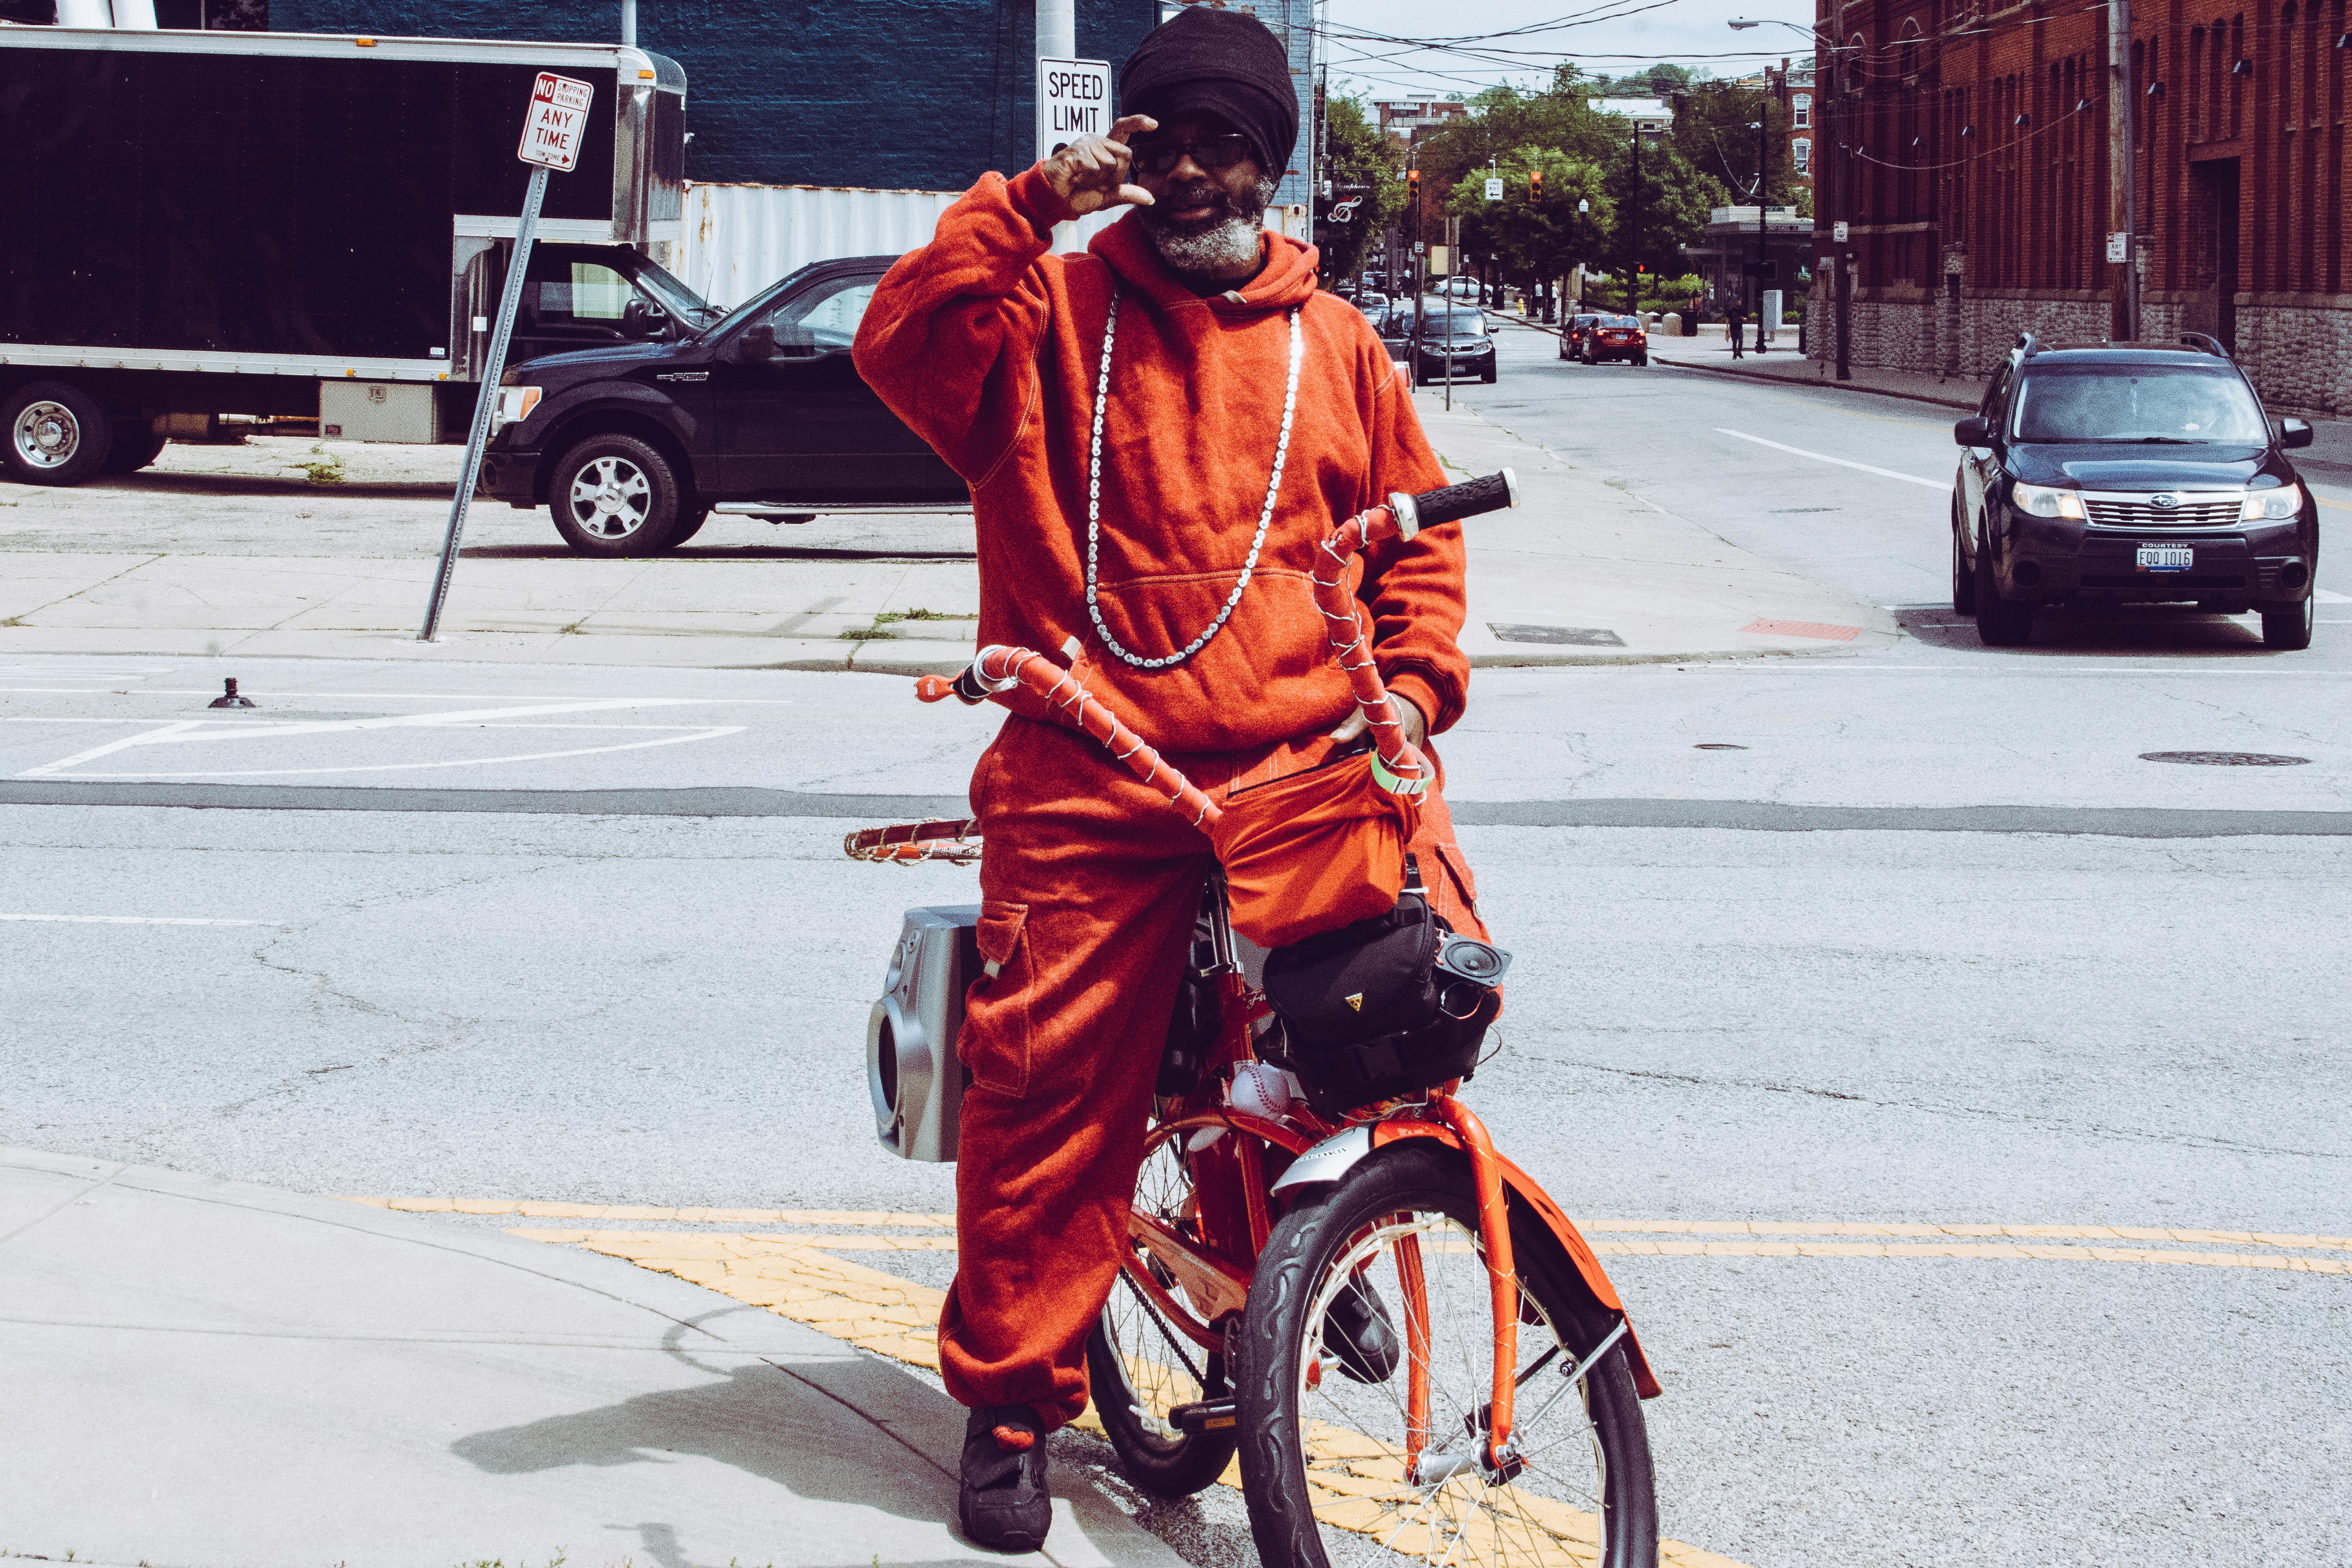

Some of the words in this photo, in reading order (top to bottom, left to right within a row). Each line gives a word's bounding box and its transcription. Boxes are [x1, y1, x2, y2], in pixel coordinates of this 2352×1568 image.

[536, 79, 554, 98] NO
[558, 83, 587, 97] STOPPING
[1049, 72, 1103, 100] SPEED
[557, 93, 583, 106] PARKING
[540, 108, 573, 128] ANY
[1054, 105, 1099, 132] LIMIT
[537, 127, 570, 149] TIME
[2164, 552, 2190, 565] 1016
